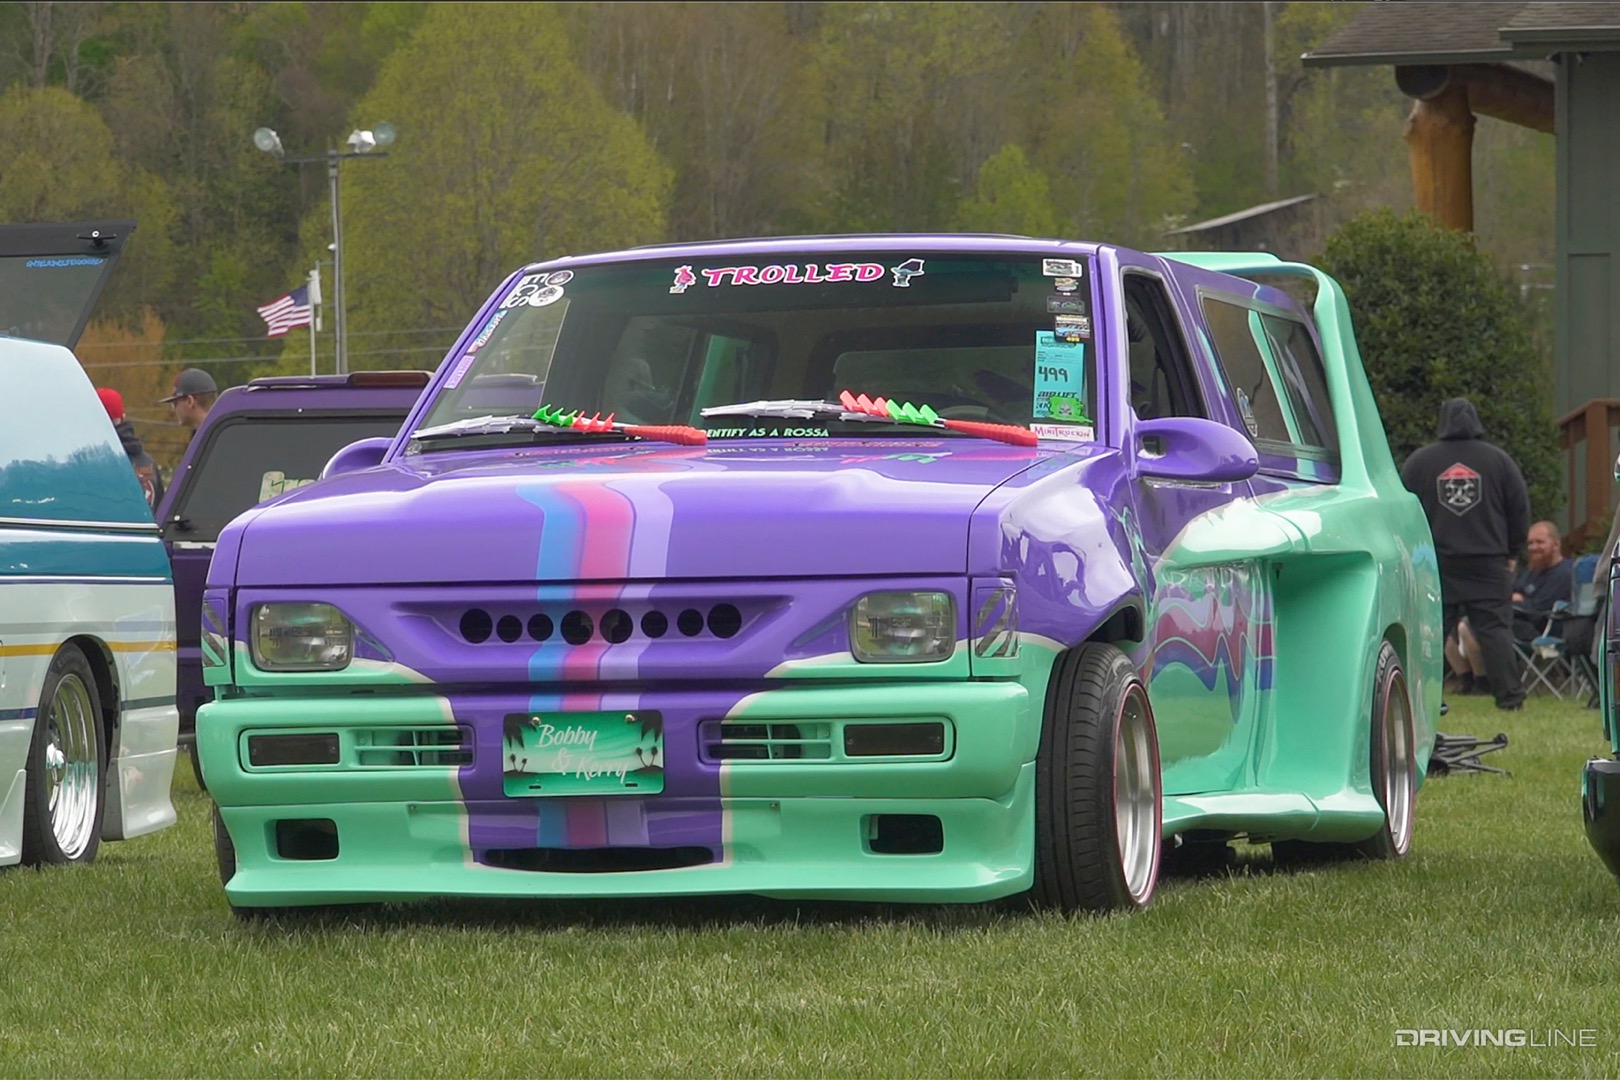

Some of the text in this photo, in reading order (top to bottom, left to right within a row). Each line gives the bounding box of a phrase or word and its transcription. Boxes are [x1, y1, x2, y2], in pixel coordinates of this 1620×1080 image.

[701, 263, 884, 287] TROLLED
[1038, 366, 1069, 383] 499
[704, 428, 830, 438] ENTIFY AS A ROSSA
[534, 724, 598, 751] Bobby
[551, 747, 629, 784] & Kerry
